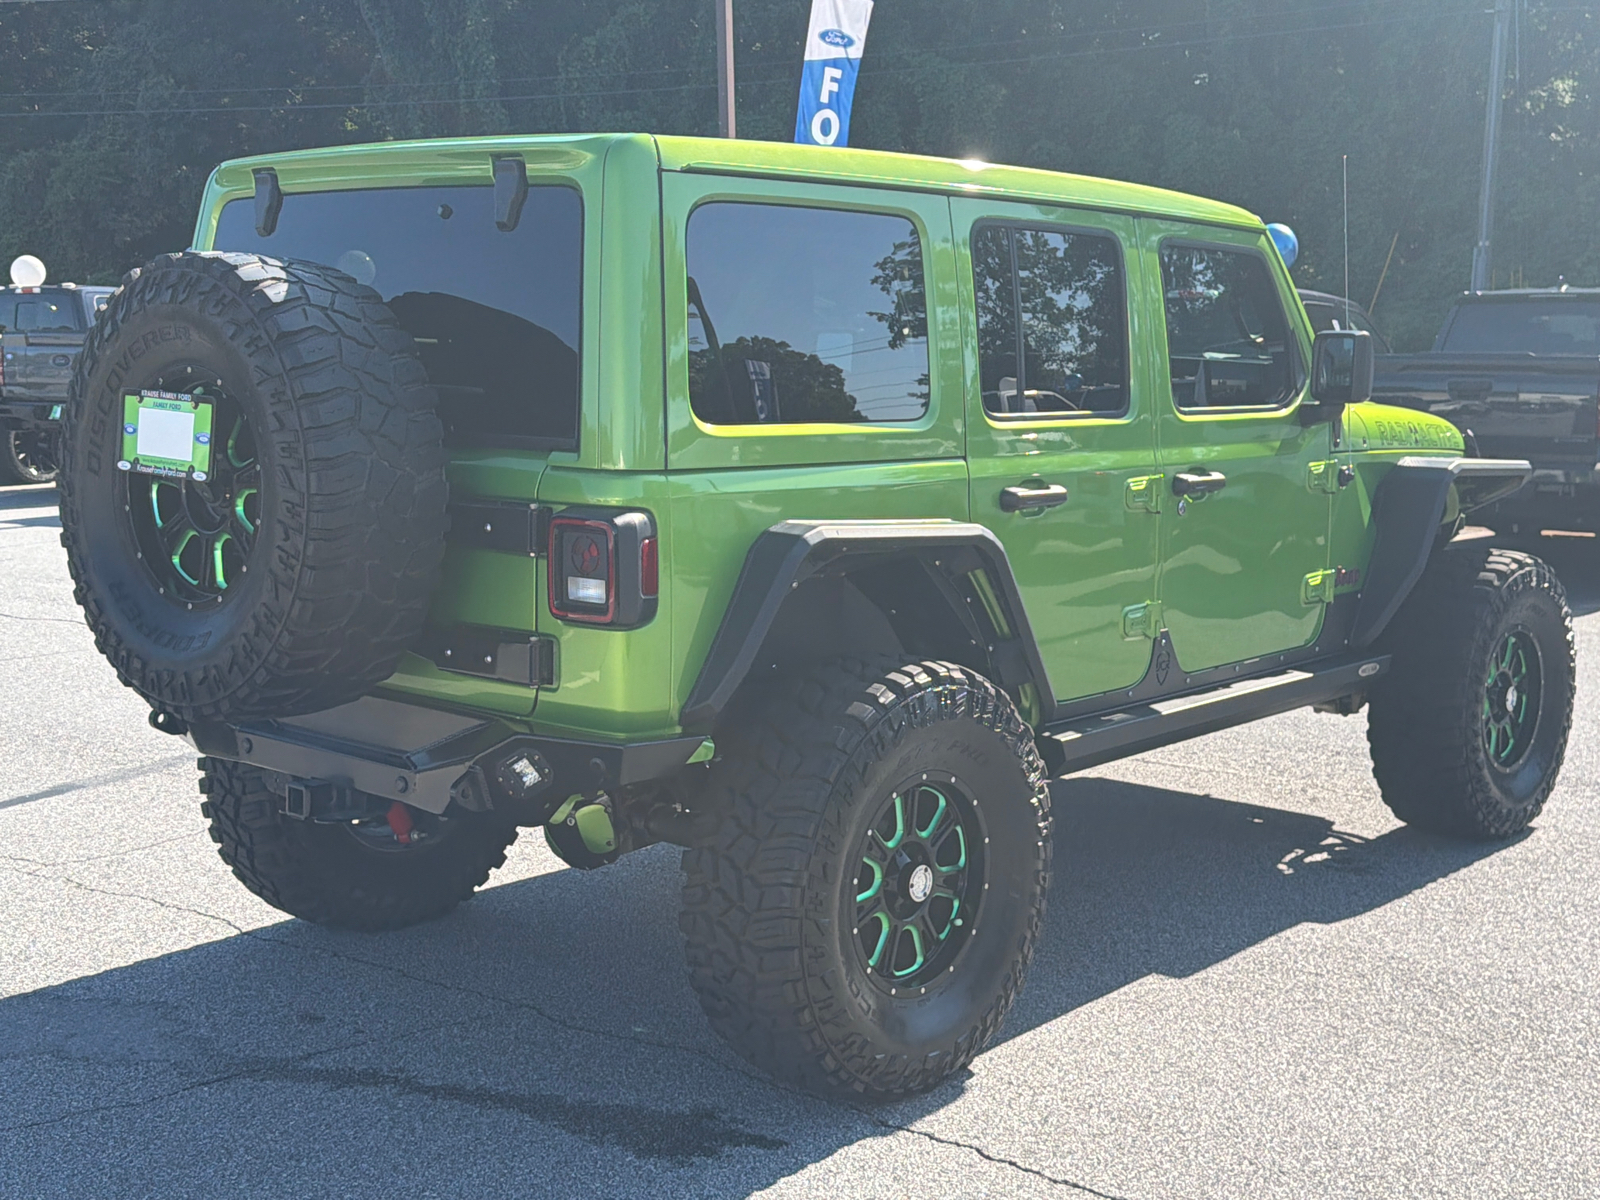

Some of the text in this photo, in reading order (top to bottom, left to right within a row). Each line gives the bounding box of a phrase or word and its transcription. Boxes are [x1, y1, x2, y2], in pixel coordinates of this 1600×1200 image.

[825, 31, 848, 45] Ford
[86, 323, 193, 479] DISCOVERER
[141, 389, 192, 401] KRAUSE FAMILY FORD
[152, 401, 168, 409] FAMILY
